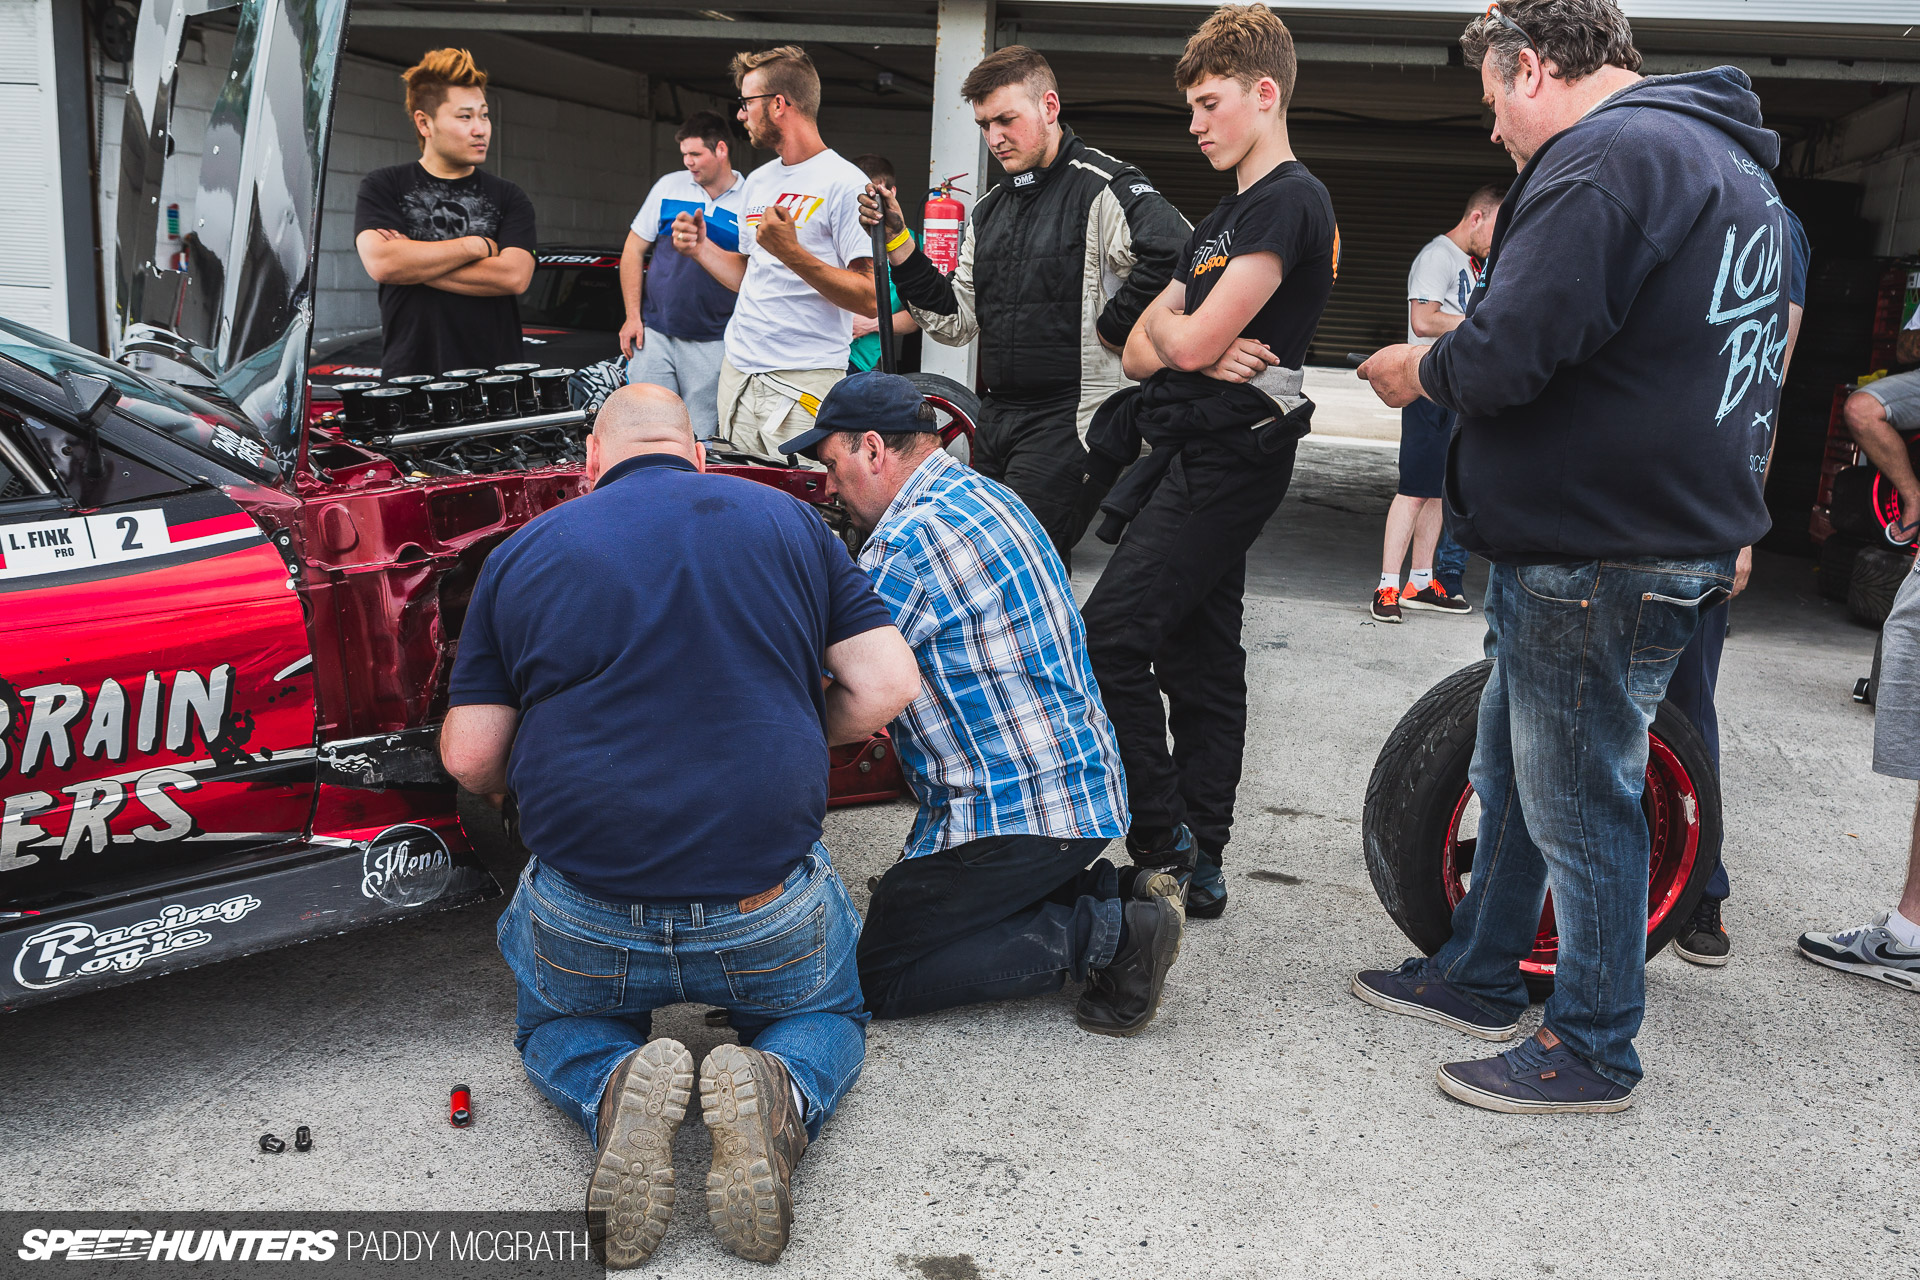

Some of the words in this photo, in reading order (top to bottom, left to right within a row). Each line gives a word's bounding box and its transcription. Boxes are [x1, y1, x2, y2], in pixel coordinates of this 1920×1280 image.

[1014, 173, 1035, 186] OMP
[1705, 217, 1783, 325] LOW
[8, 533, 26, 551] L.
[27, 528, 73, 549] FINK
[115, 516, 144, 551] 2
[54, 547, 75, 558] PRO
[23, 895, 261, 964] Racing
[43, 930, 212, 980] Logic
